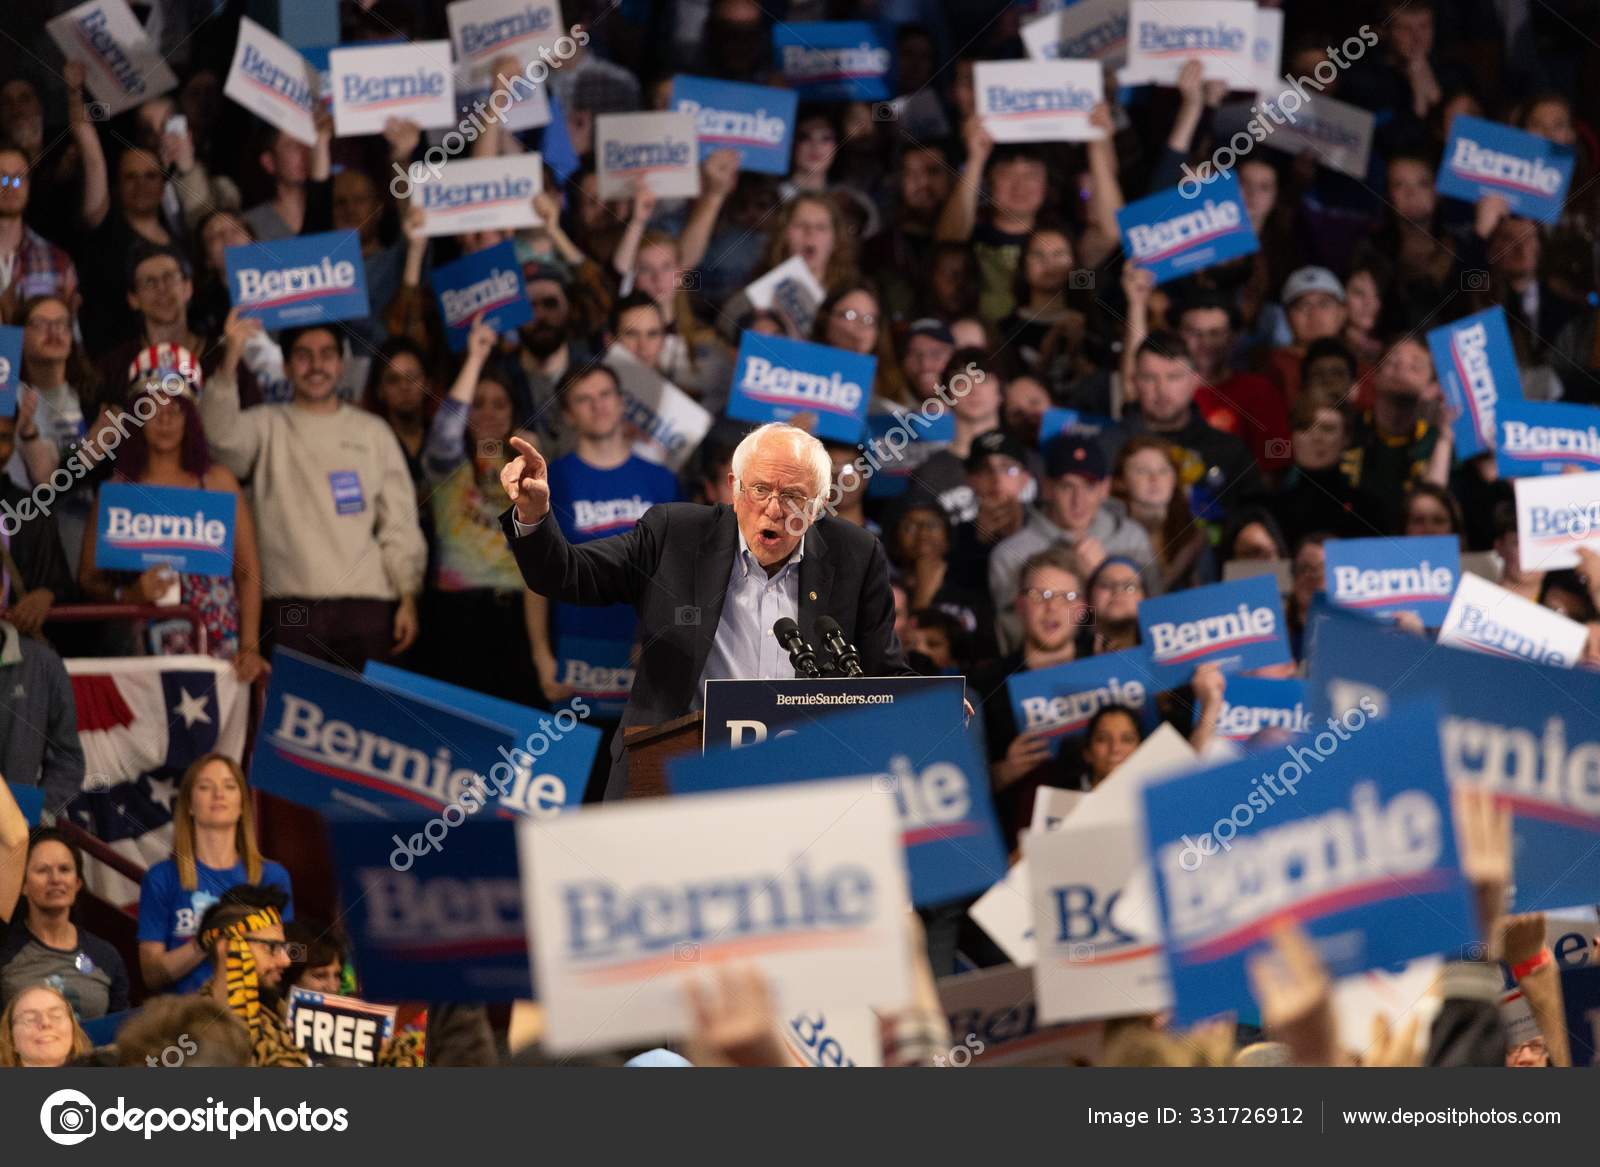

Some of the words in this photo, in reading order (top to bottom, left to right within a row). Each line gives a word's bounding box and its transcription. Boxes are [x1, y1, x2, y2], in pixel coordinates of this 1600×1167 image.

[79, 7, 147, 97] Bernie
[459, 3, 552, 57] Bernie
[1137, 19, 1246, 51] Bernie
[342, 67, 445, 101] Bernie
[782, 41, 891, 78] Bernie
[985, 83, 1096, 114] Bernie
[603, 133, 691, 171] Bernie
[1452, 135, 1563, 194] Bernie
[423, 172, 533, 208] Bernie
[1126, 197, 1243, 257] Bernie
[235, 255, 356, 302] Bernie
[440, 265, 520, 319] Bernie
[740, 353, 865, 413] Bernie
[106, 506, 227, 548] Bernie
[1333, 559, 1455, 600] Bernie
[1150, 603, 1276, 656] Bernie
[1456, 604, 1567, 669] Bernie
[776, 692, 894, 706] BernieSanders.com
[1020, 676, 1148, 731] Bernie
[276, 693, 484, 815] Bernie
[1162, 780, 1443, 938] Bernie
[558, 851, 875, 956] Bernie
[298, 1005, 376, 1063] FREE
